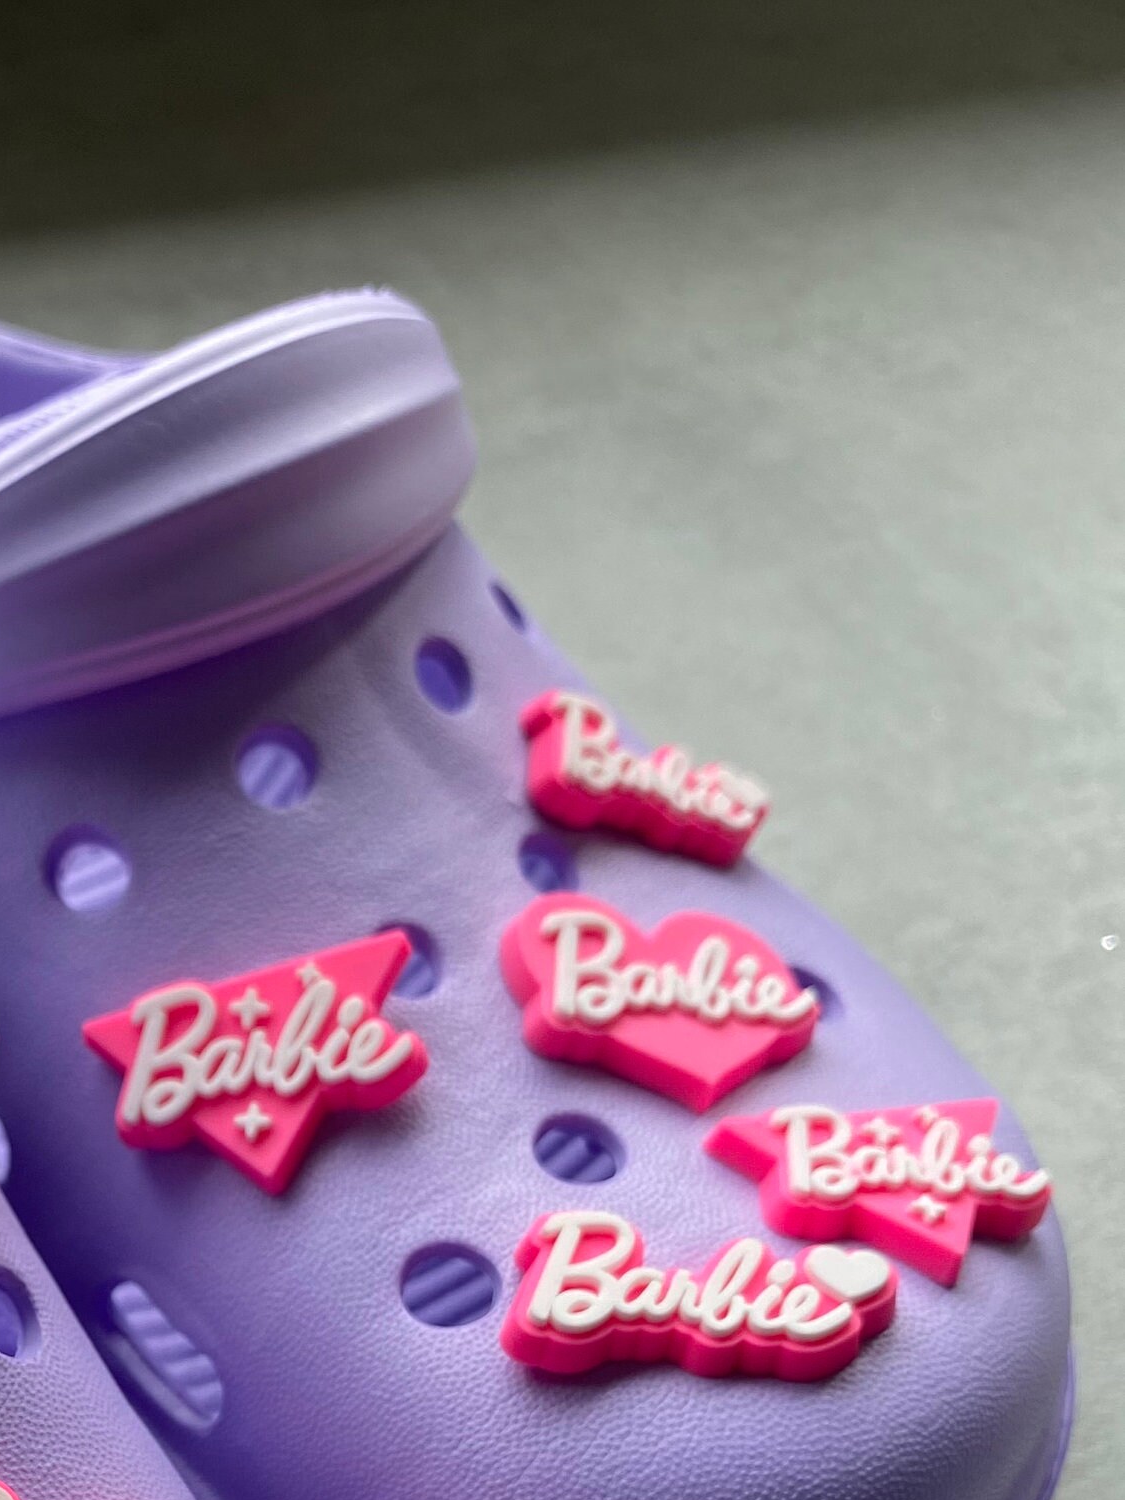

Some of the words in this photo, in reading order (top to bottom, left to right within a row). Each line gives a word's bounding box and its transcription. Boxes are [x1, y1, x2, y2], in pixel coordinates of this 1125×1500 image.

[551, 694, 755, 828] Barbie
[541, 911, 816, 1022] Barbie
[124, 978, 414, 1127] Barbie
[771, 1106, 1050, 1196] Barbie
[529, 1210, 852, 1340] Barbie
